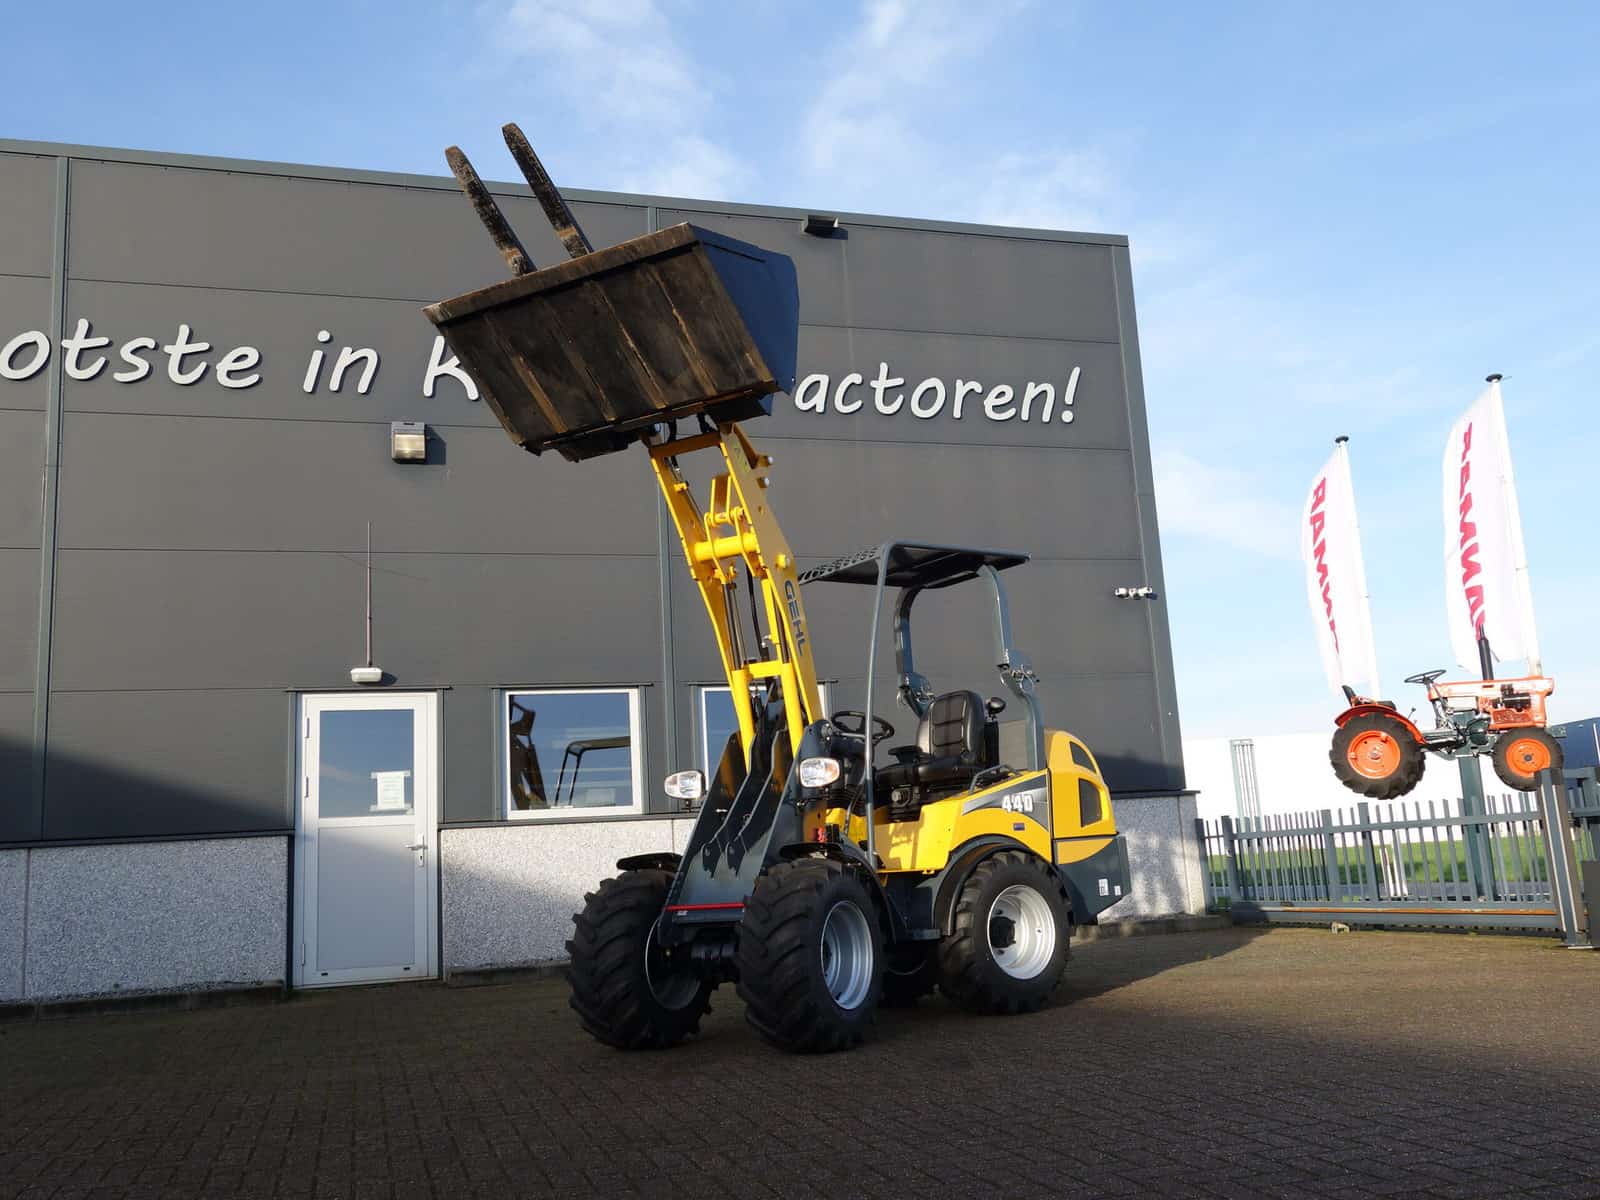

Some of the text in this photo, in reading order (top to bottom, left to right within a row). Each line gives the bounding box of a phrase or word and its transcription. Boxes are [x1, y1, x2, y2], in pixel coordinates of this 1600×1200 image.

[0, 318, 260, 388] otste
[303, 330, 379, 394] in
[794, 361, 1081, 423] actoren!
[784, 580, 806, 657] GEHL
[1002, 794, 1033, 812] 440
